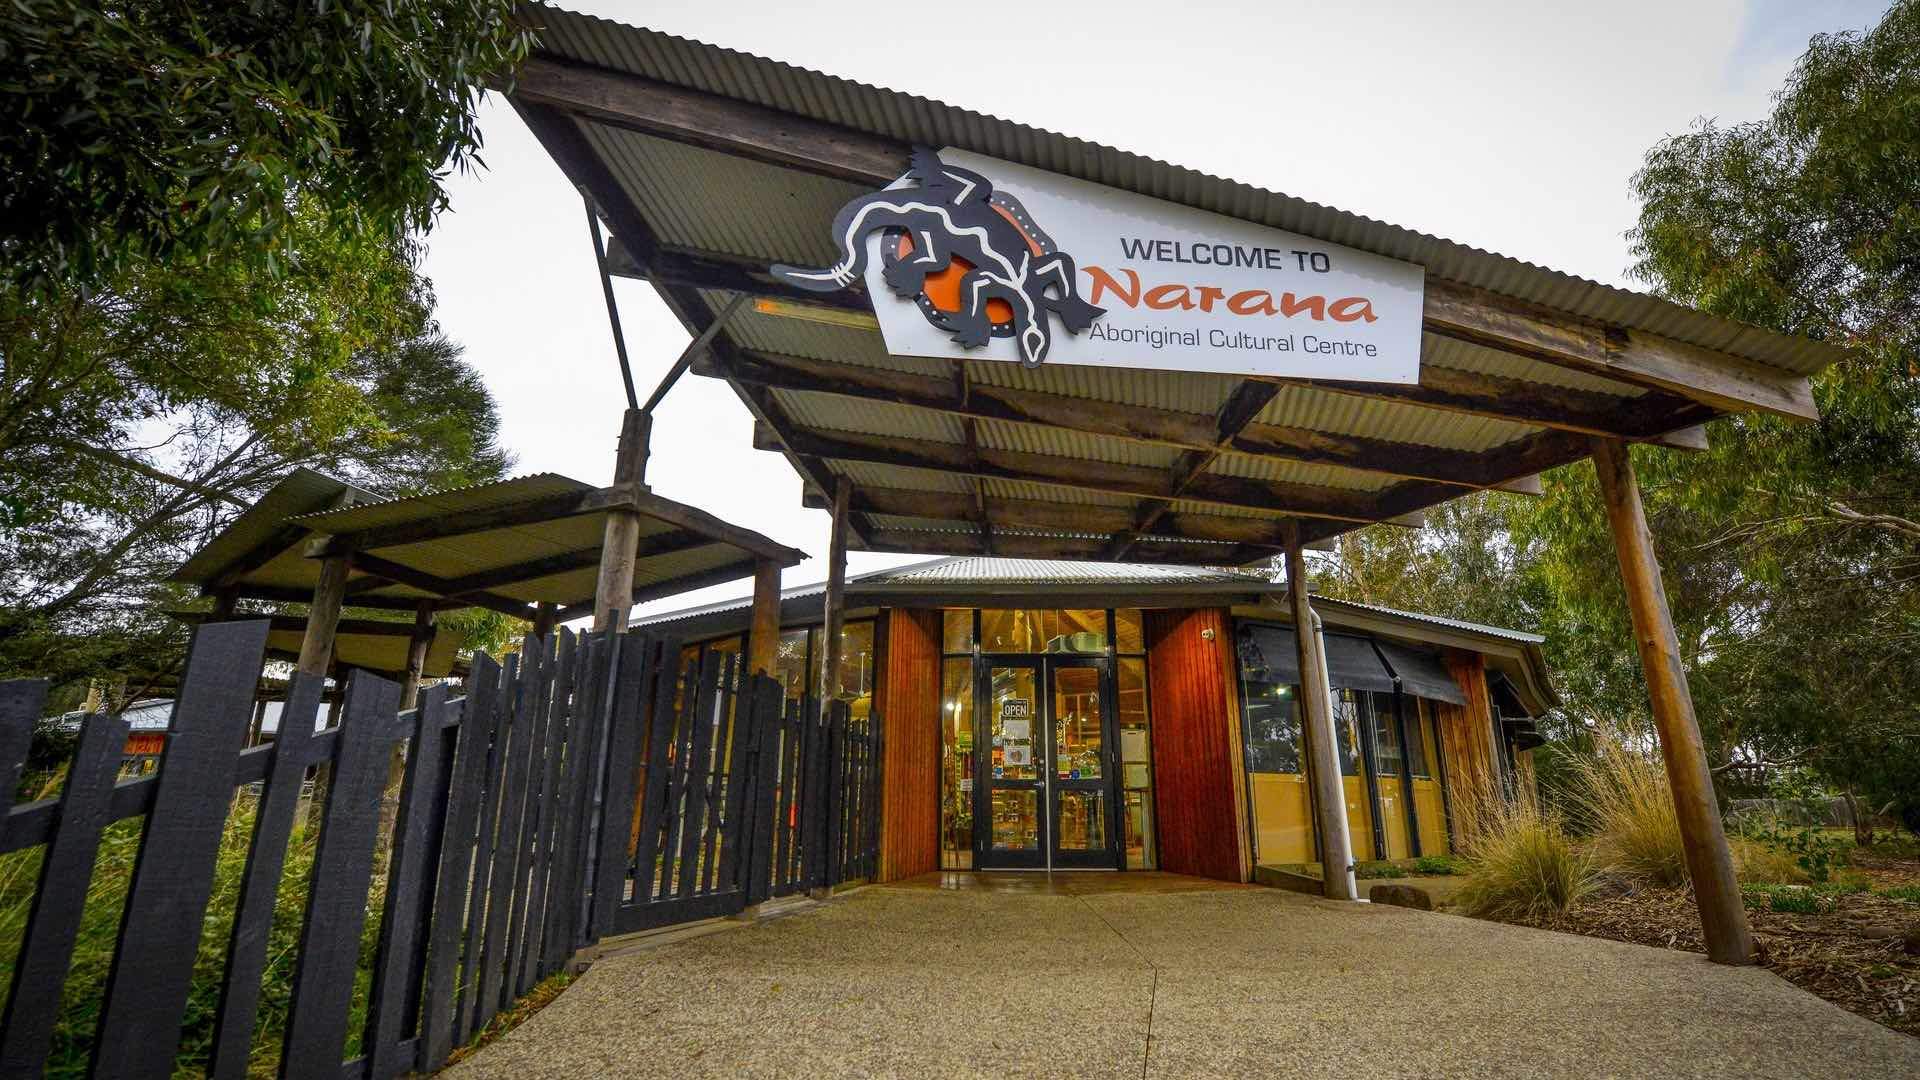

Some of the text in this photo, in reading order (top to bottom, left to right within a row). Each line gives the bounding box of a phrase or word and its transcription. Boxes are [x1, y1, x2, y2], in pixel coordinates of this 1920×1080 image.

[1120, 237, 1331, 273] WELCOME TO
[1079, 265, 1379, 323] Narana
[1089, 322, 1378, 357] Aboriginal Cultural Centre
[1004, 704, 1027, 716] OPEN
